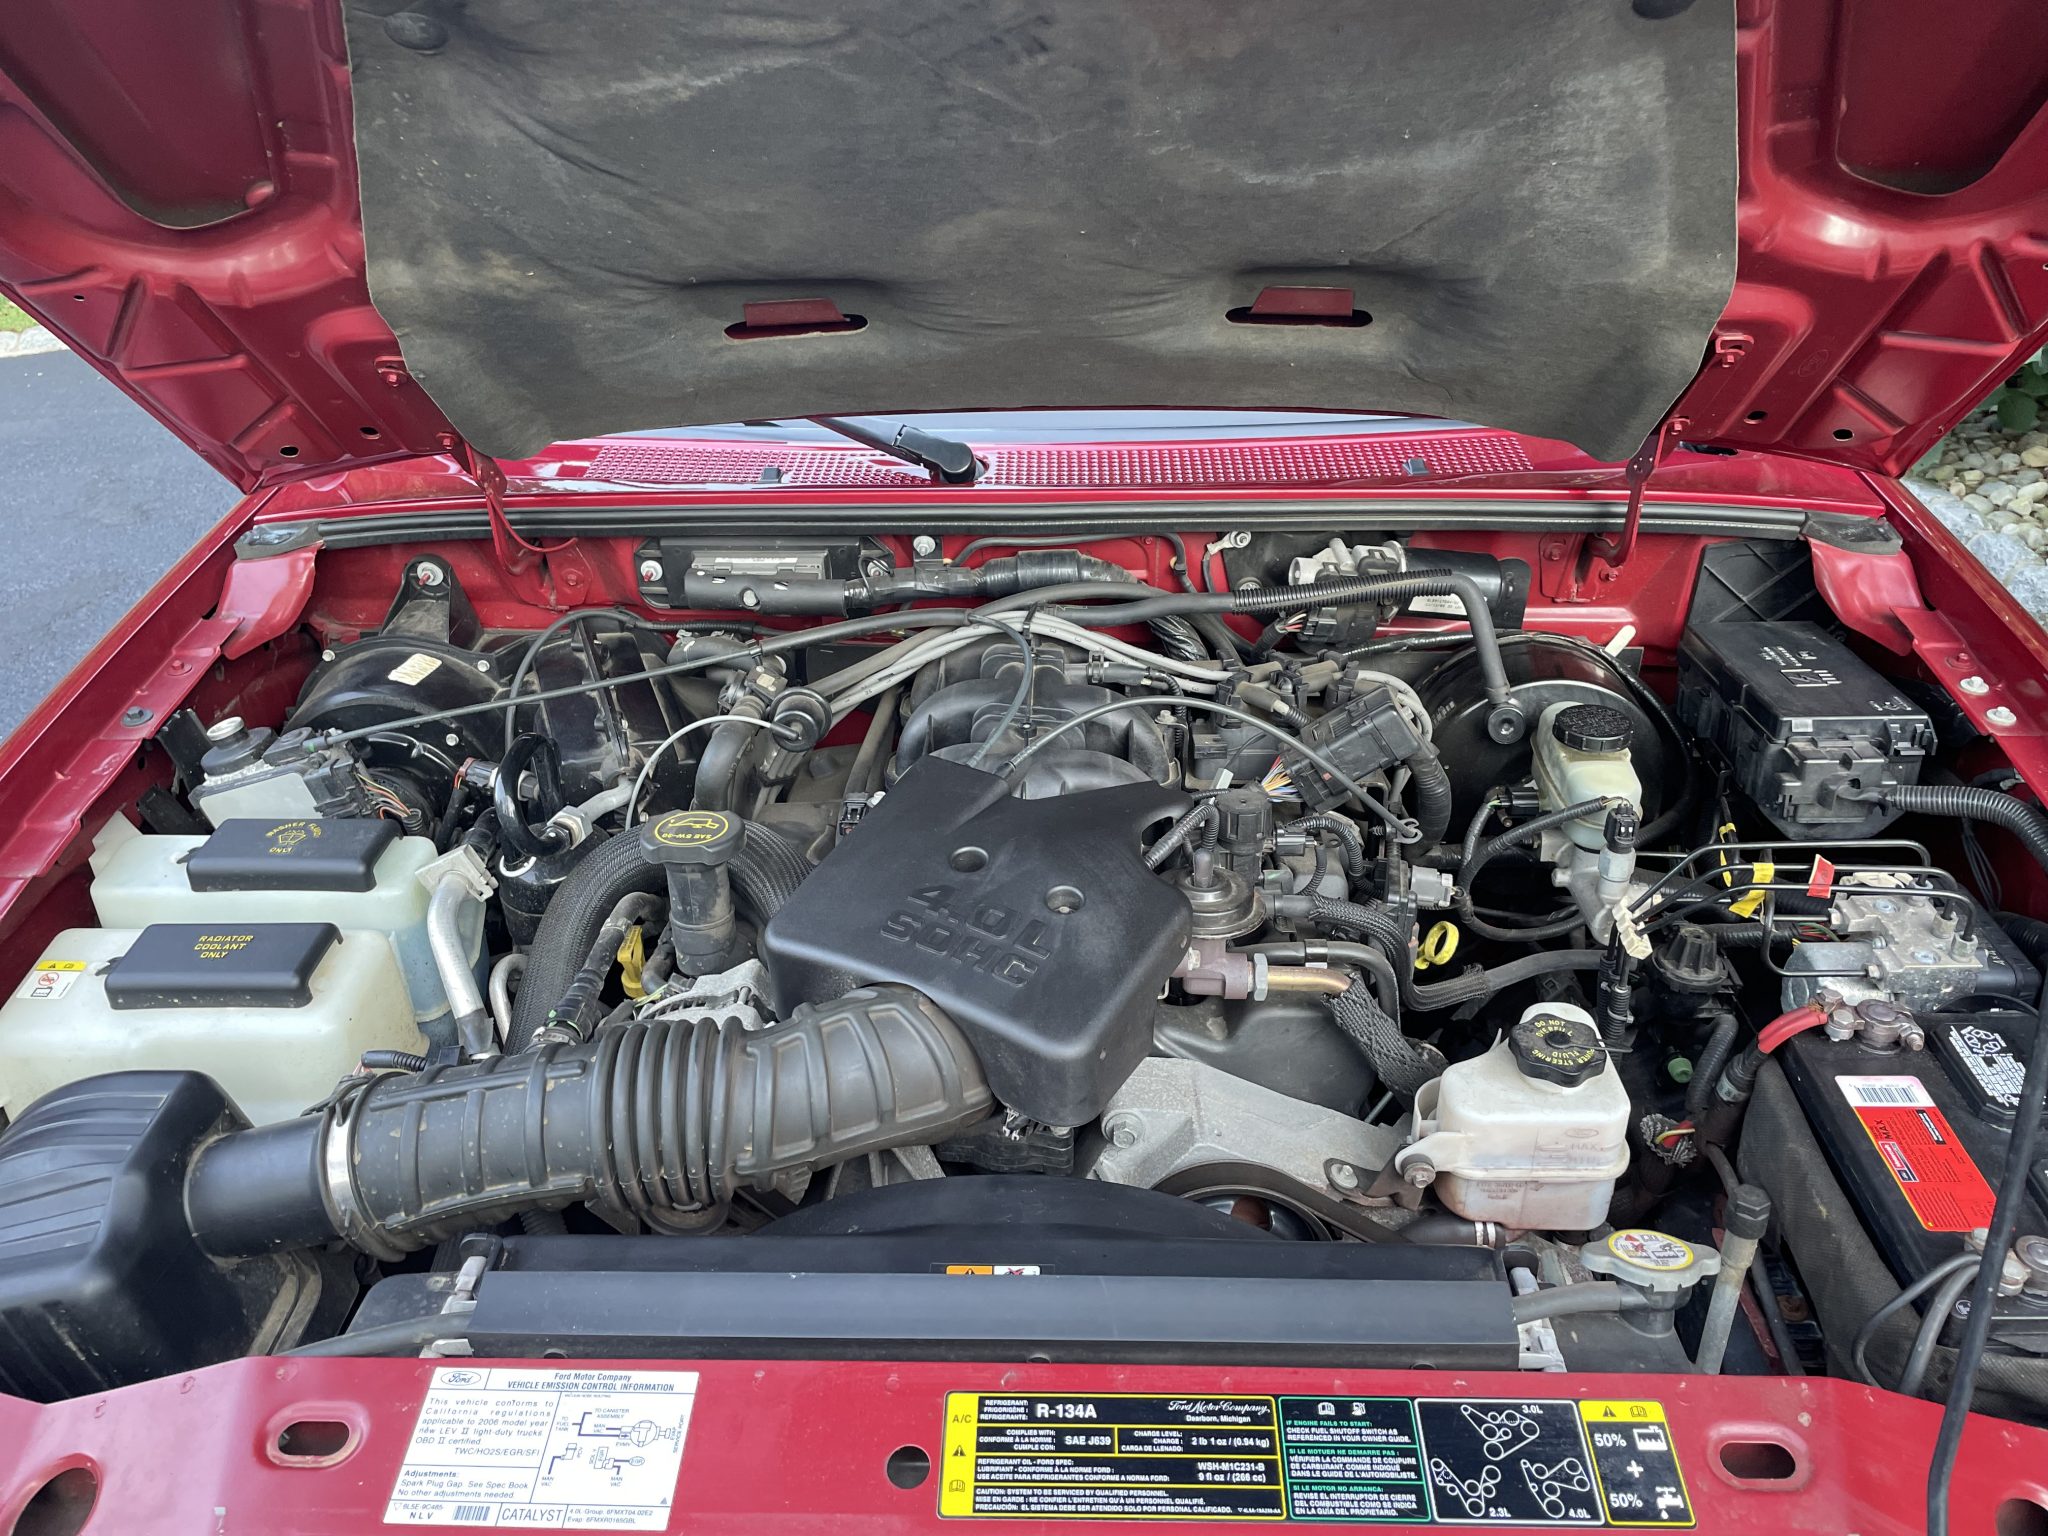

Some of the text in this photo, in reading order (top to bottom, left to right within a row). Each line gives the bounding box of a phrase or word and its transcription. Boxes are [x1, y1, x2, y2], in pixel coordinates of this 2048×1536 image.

[880, 909, 1039, 988] SOHC
[1531, 1049, 1574, 1065] STEERING
[1552, 1050, 1579, 1058] FLUID
[554, 1372, 632, 1383] Ford Motor Company
[508, 1381, 675, 1392] VEHICLE EMISSION CONTROL INFORMATION
[429, 1397, 448, 1406] This
[455, 1398, 489, 1406] vehicle
[495, 1399, 538, 1407] conforms
[1168, 1400, 1191, 1412] Ford
[1190, 1400, 1221, 1414] Motor
[425, 1407, 551, 1419] California regulations
[1036, 1403, 1098, 1418] R-134A
[1522, 1405, 1543, 1414] 3.0L
[421, 1417, 464, 1427] applicable
[477, 1418, 499, 1426] 2006
[501, 1418, 527, 1427] model
[529, 1420, 548, 1428] year
[952, 1414, 972, 1424] A/C
[1220, 1415, 1251, 1424] Michigan
[439, 1427, 457, 1435] LEV
[415, 1436, 435, 1444] OBD
[1064, 1435, 1112, 1446] SAE J639
[1199, 1437, 1208, 1446] lb
[1594, 1433, 1627, 1447] 50%
[1197, 1462, 1265, 1472] WSH-M1C231-B
[1214, 1474, 1225, 1482] oz
[400, 1479, 424, 1488] Spark
[426, 1480, 444, 1488] Plug
[485, 1482, 505, 1490] Spec
[411, 1489, 431, 1497] other
[433, 1489, 482, 1499] adjustments
[1309, 1500, 1359, 1508] COMBUSTIBLE
[1393, 1501, 1417, 1509] INDICA
[1610, 1493, 1643, 1508] 50%
[502, 1508, 563, 1522] CATALYST
[1489, 1508, 1511, 1517] 2.3L
[1568, 1508, 1591, 1518] 4.0L
